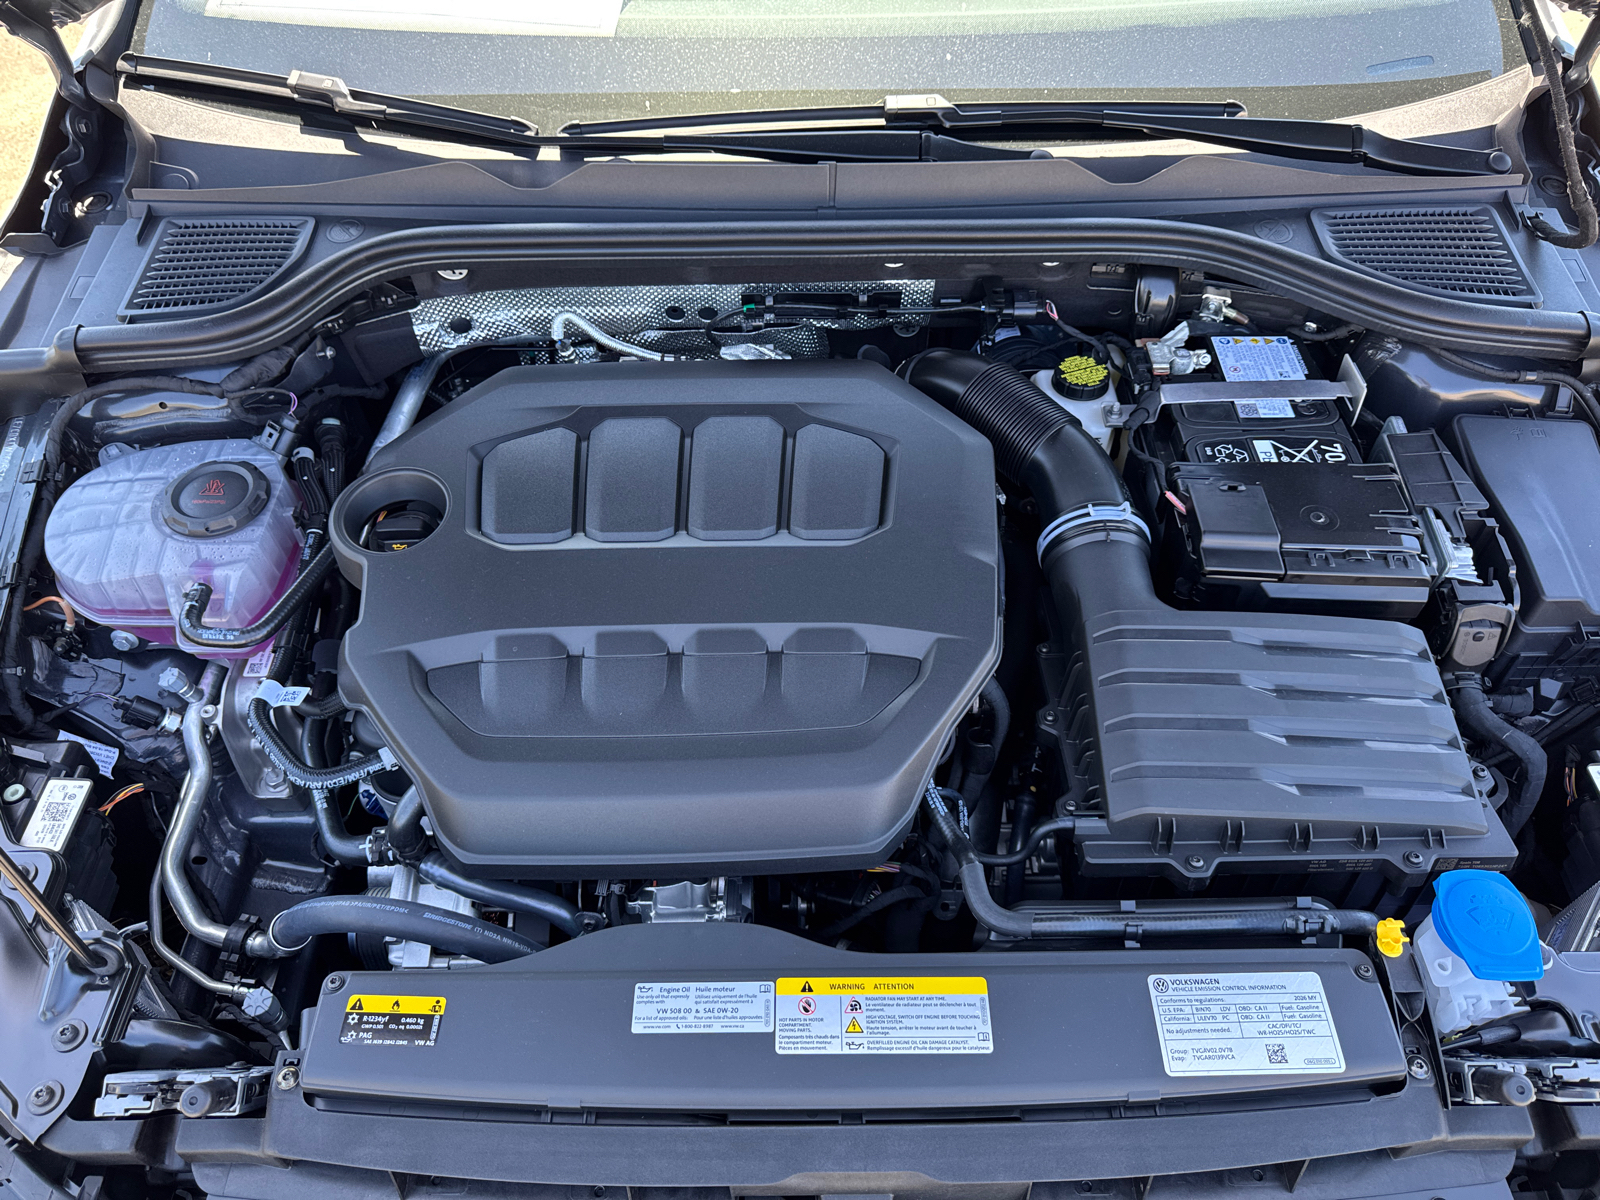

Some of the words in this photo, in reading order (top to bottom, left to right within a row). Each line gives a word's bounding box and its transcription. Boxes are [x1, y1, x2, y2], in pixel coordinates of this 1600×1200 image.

[1320, 443, 1346, 463] 70
[423, 912, 474, 930] BRIDGESTONE
[474, 926, 482, 934] (T)
[660, 986, 680, 994] Engine
[362, 1016, 389, 1024] R-1234yf
[1175, 1027, 1209, 1035] adjustments
